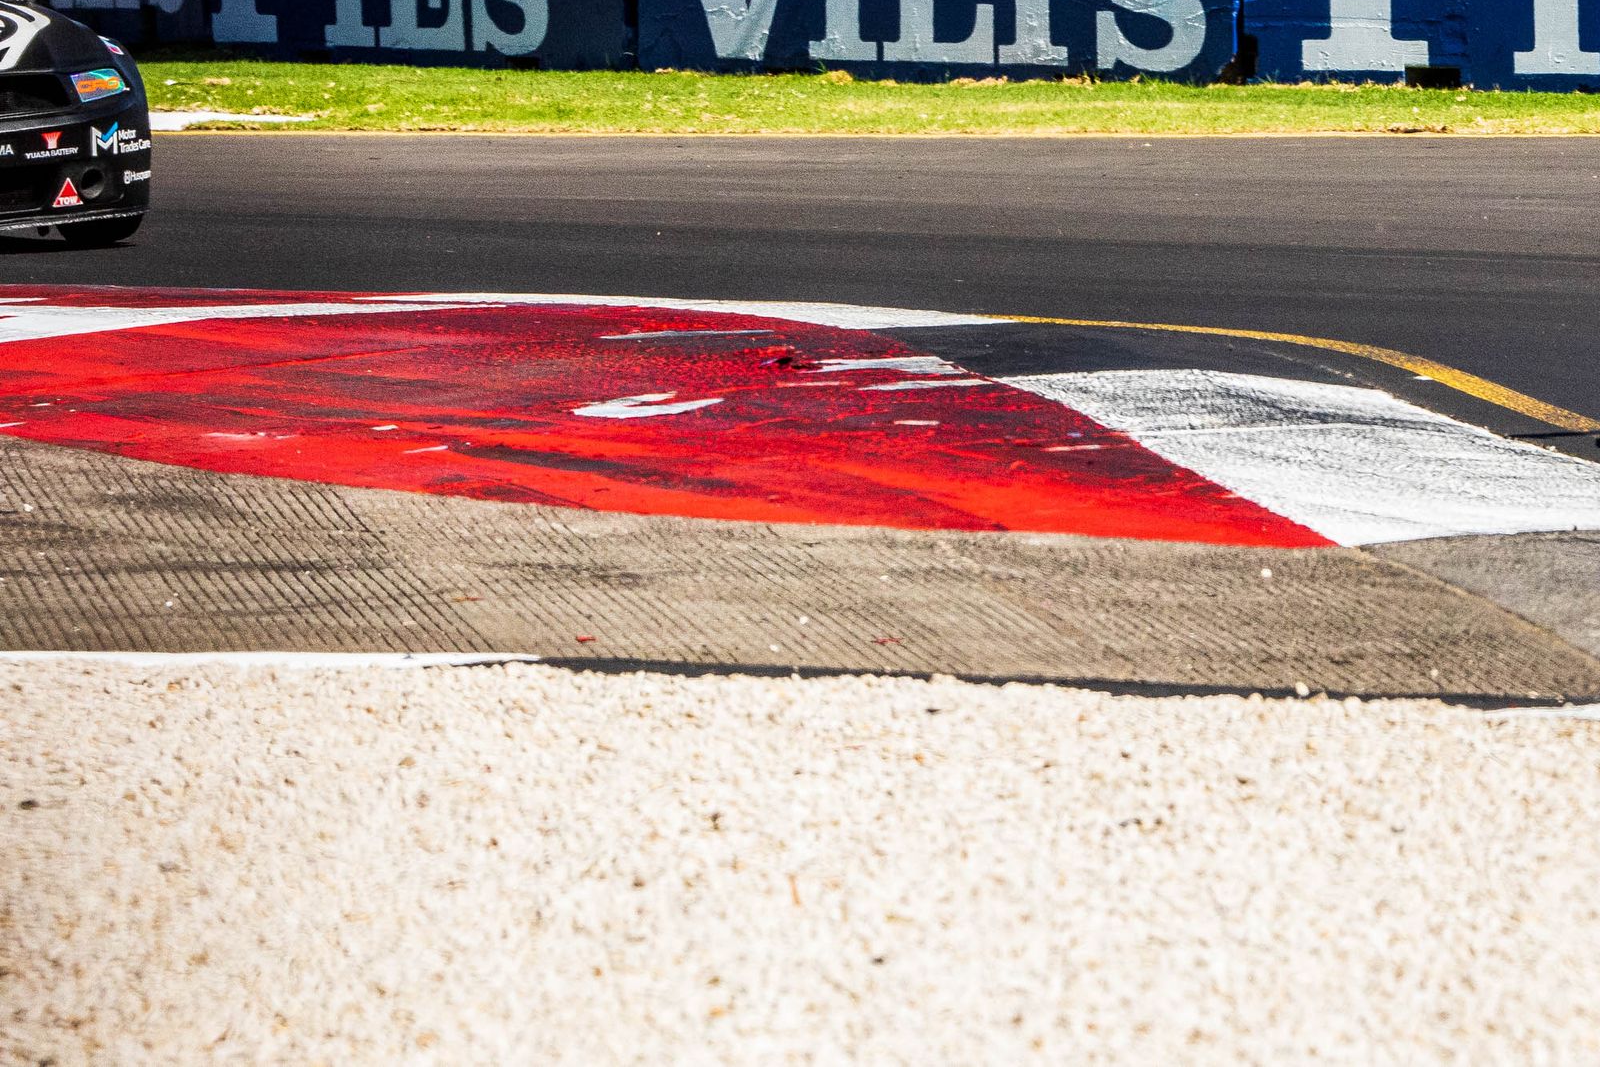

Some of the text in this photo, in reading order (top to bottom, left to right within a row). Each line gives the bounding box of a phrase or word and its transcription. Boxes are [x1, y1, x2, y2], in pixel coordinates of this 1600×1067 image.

[118, 129, 136, 140] Motor
[25, 146, 79, 159] YUASA BATTERY
[119, 141, 139, 153] Trades
[60, 196, 78, 204] TOW
